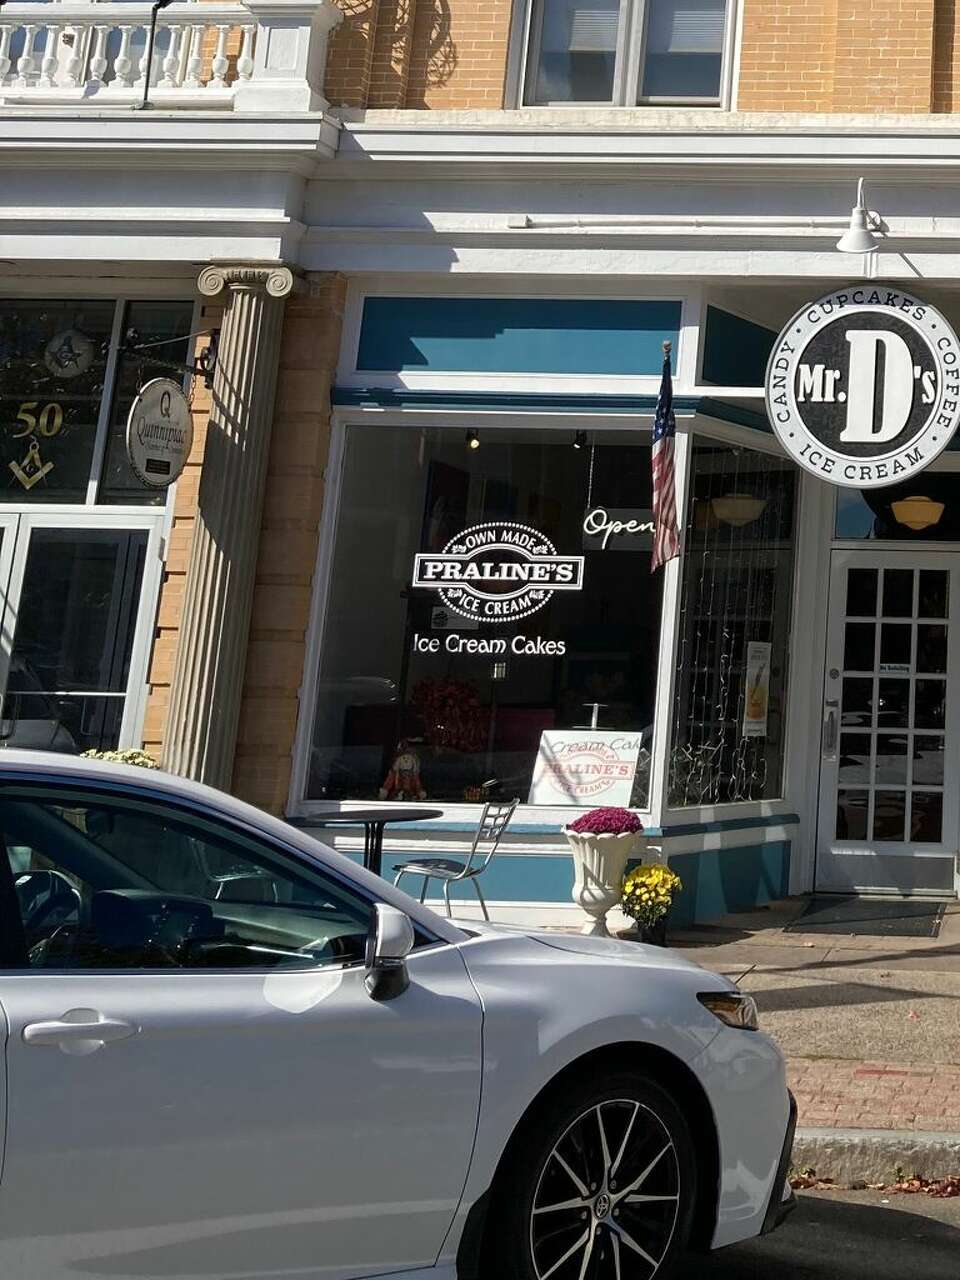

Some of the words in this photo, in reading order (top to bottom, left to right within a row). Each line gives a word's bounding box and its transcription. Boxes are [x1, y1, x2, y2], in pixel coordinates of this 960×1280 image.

[807, 290, 926, 323] CUPCAKES
[773, 340, 796, 423] CANDY
[797, 364, 847, 403] Mr.
[840, 329, 936, 442] D's
[936, 336, 960, 428] COFFEE
[12, 401, 64, 439] 50
[161, 391, 170, 418] Q
[799, 443, 836, 473] ICE
[844, 446, 925, 480] CREAM
[466, 530, 497, 549] OWN
[501, 530, 535, 550] MADE
[583, 509, 656, 550] Open
[423, 561, 573, 582] PRALINE'S
[459, 593, 480, 612] ICE
[485, 597, 532, 615] CREAM
[413, 633, 440, 653] Ice
[445, 634, 507, 654] Cream
[511, 635, 566, 656] Cakes
